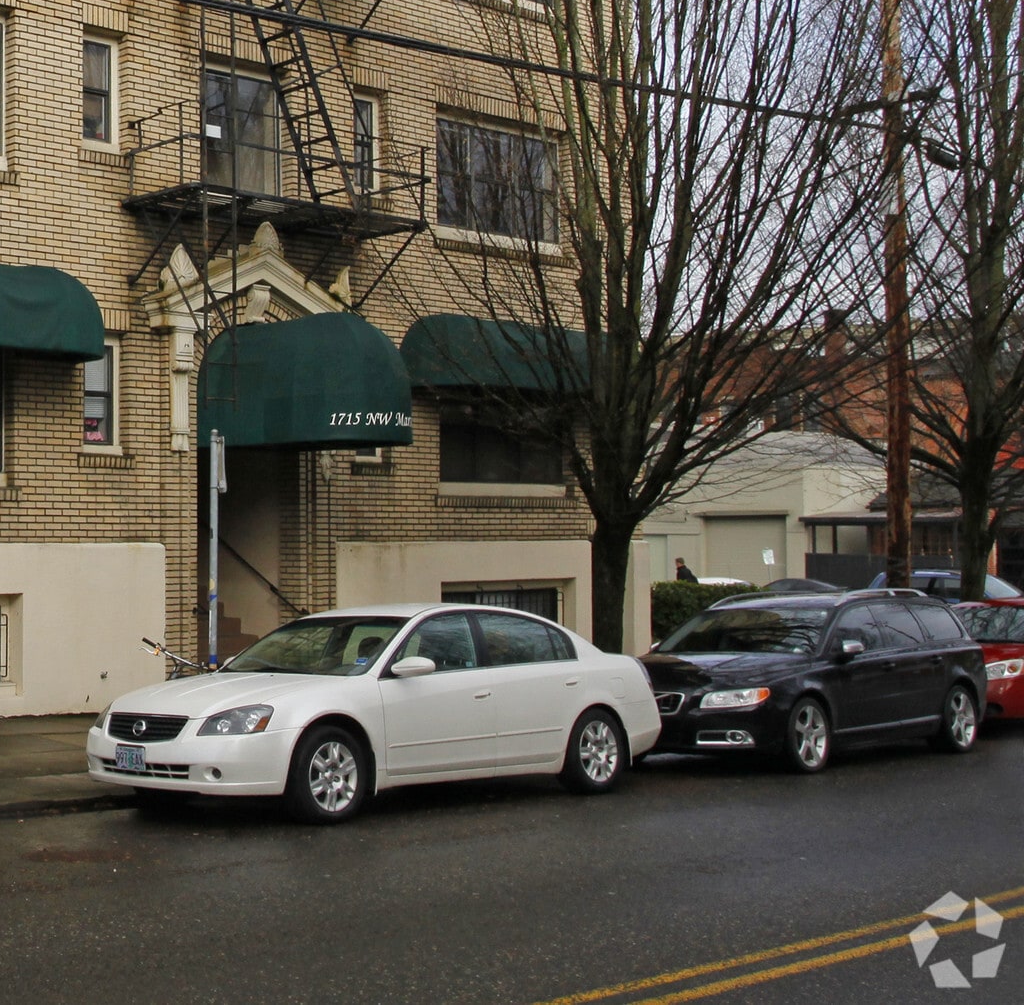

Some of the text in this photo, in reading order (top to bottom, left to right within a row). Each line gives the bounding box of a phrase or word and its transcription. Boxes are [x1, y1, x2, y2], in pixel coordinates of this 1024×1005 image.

[329, 411, 413, 427] 1715 NW Mar
